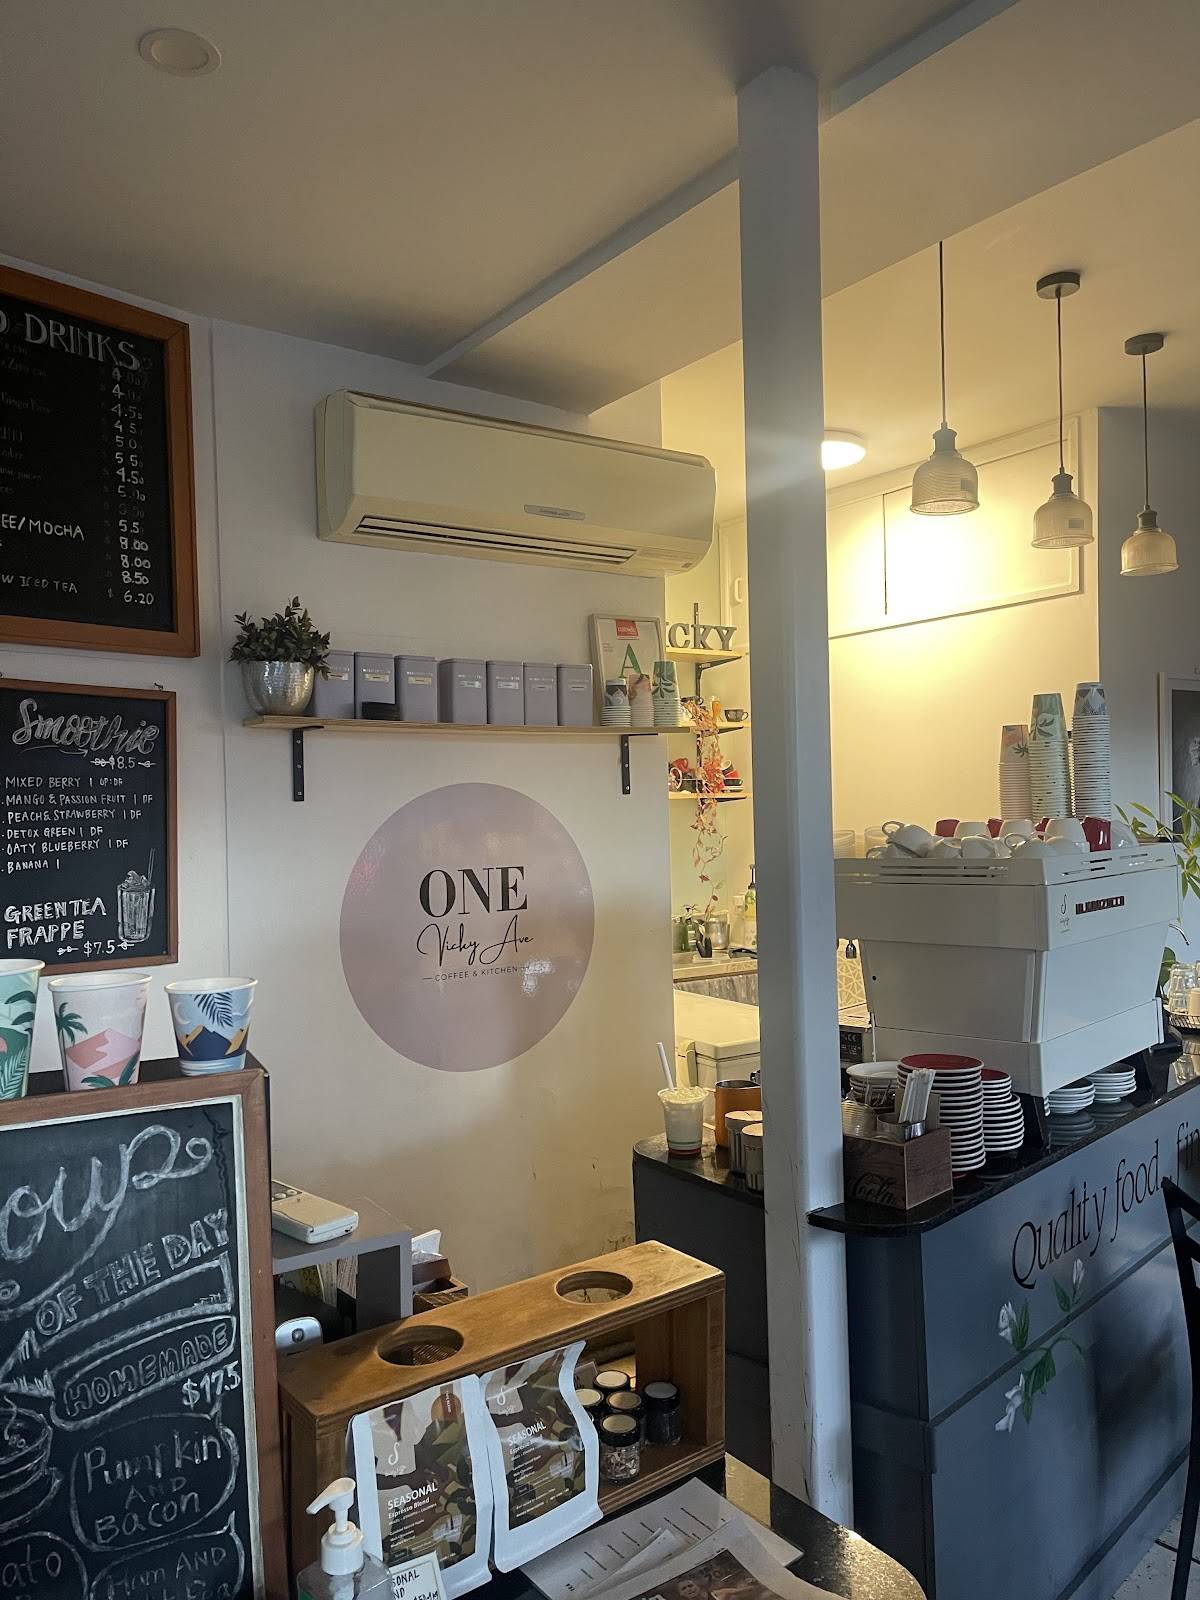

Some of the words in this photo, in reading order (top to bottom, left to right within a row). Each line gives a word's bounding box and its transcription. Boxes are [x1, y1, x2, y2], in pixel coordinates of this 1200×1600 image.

[24, 313, 142, 371] DRINKS
[53, 580, 79, 594] TEA
[618, 643, 643, 679] A
[11, 697, 160, 755] Smoothie
[5, 777, 43, 788] MIXED
[48, 777, 81, 789] BERRY
[6, 794, 45, 806] MANGO
[59, 795, 97, 806] PASSION
[101, 794, 126, 804] FRUIT
[142, 794, 153, 804] DF
[54, 809, 116, 821] STRAWBERRY
[130, 809, 142, 819] DF
[7, 829, 39, 840] DETOX
[43, 827, 76, 838] GREEN
[90, 826, 103, 836] DF
[6, 843, 36, 856] OATY
[41, 839, 100, 854] BLUEBERRY
[116, 839, 129, 848] DF
[7, 860, 49, 874] BANANA
[419, 866, 528, 918] ONE
[4, 902, 67, 924] GREEN
[69, 897, 107, 917] TEA
[6, 920, 86, 949] FRAPPE
[83, 939, 116, 957] $7.5
[416, 922, 481, 968] Vicky
[479, 914, 535, 965] Ave
[434, 970, 469, 982] COFFEE
[481, 966, 518, 977] KITCHEN
[1011, 1180, 1108, 1290] Quality
[1109, 1138, 1161, 1244] food
[35, 1284, 84, 1337] OF
[83, 1241, 161, 1304] THE
[161, 1207, 230, 1271] DAY
[62, 1326, 230, 1418] HOMEMADE
[508, 1420, 548, 1447] SEASONAL
[386, 1482, 439, 1512] SEASONAL
[388, 1504, 414, 1520] Espresso
[413, 1496, 431, 1510] Blend
[95, 1491, 201, 1544] Bacon
[175, 1547, 227, 1580] AND
